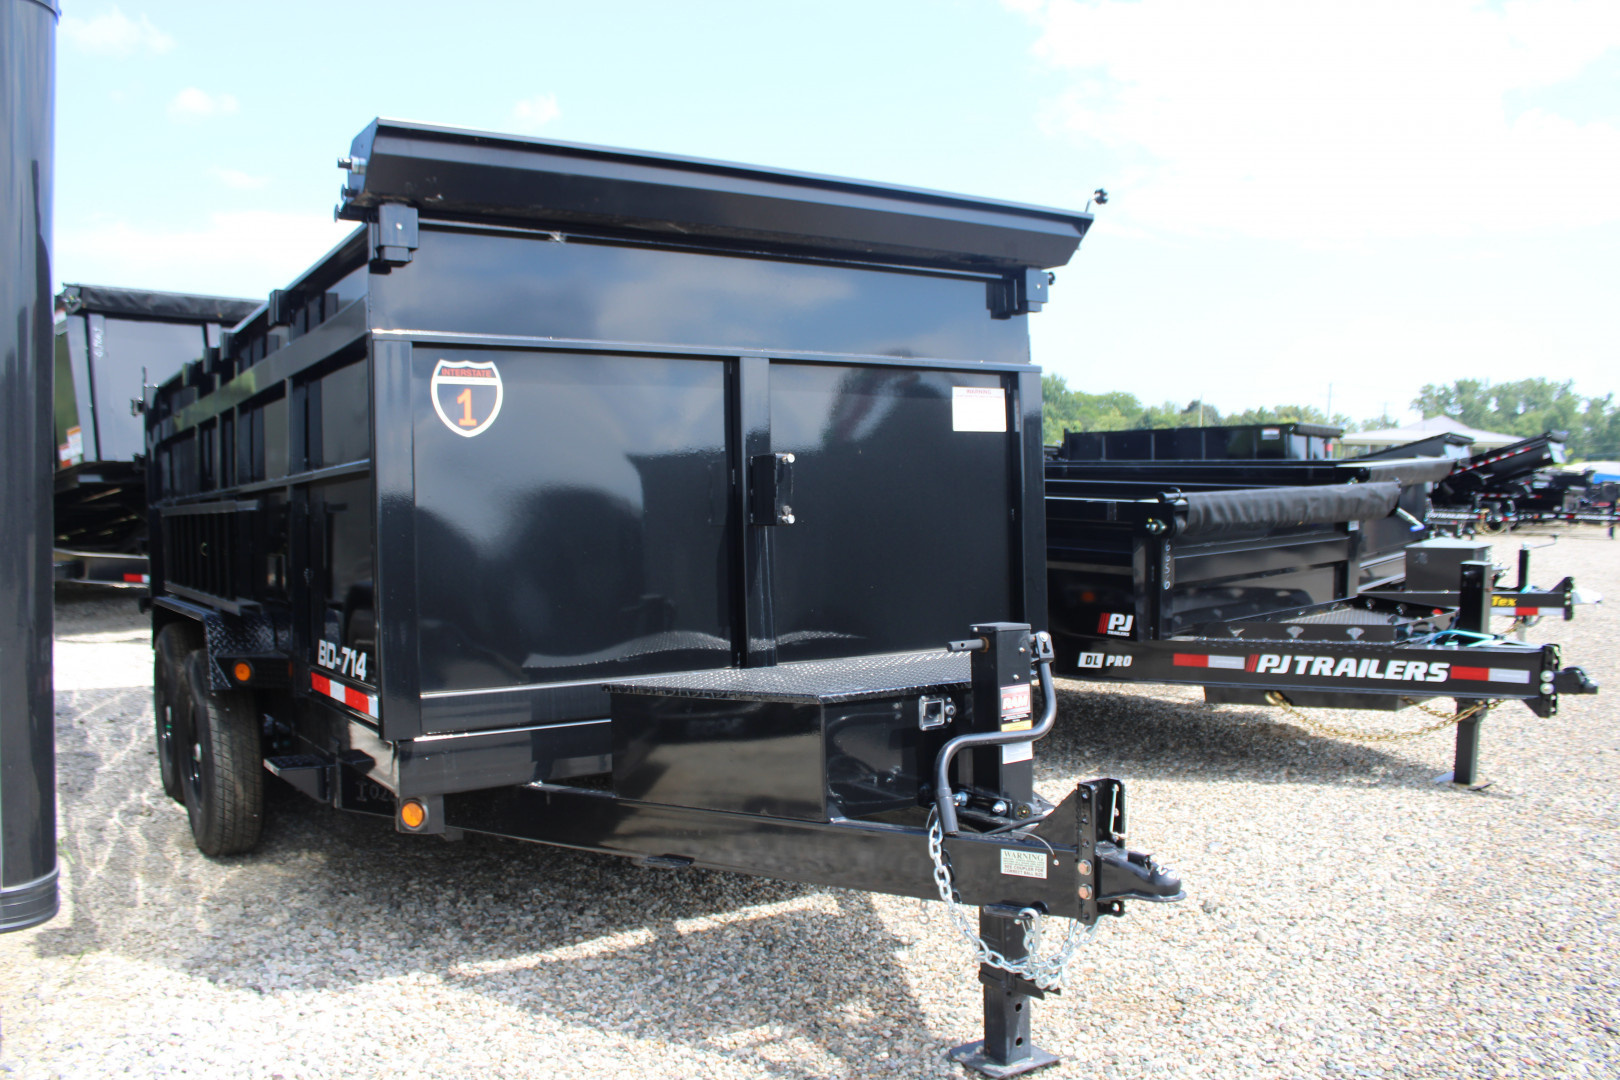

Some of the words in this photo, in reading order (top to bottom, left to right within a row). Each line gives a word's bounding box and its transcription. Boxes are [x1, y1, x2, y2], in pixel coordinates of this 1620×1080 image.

[441, 367, 492, 378] INTERSTATE
[456, 387, 478, 427] 1
[1491, 595, 1518, 608] Tex
[1107, 613, 1134, 632] PJ
[317, 639, 367, 681] BD-714
[1085, 654, 1099, 666] DL
[1105, 655, 1133, 667] PRO
[1002, 695, 1029, 710] RAM
[1004, 851, 1044, 861] WARNING
